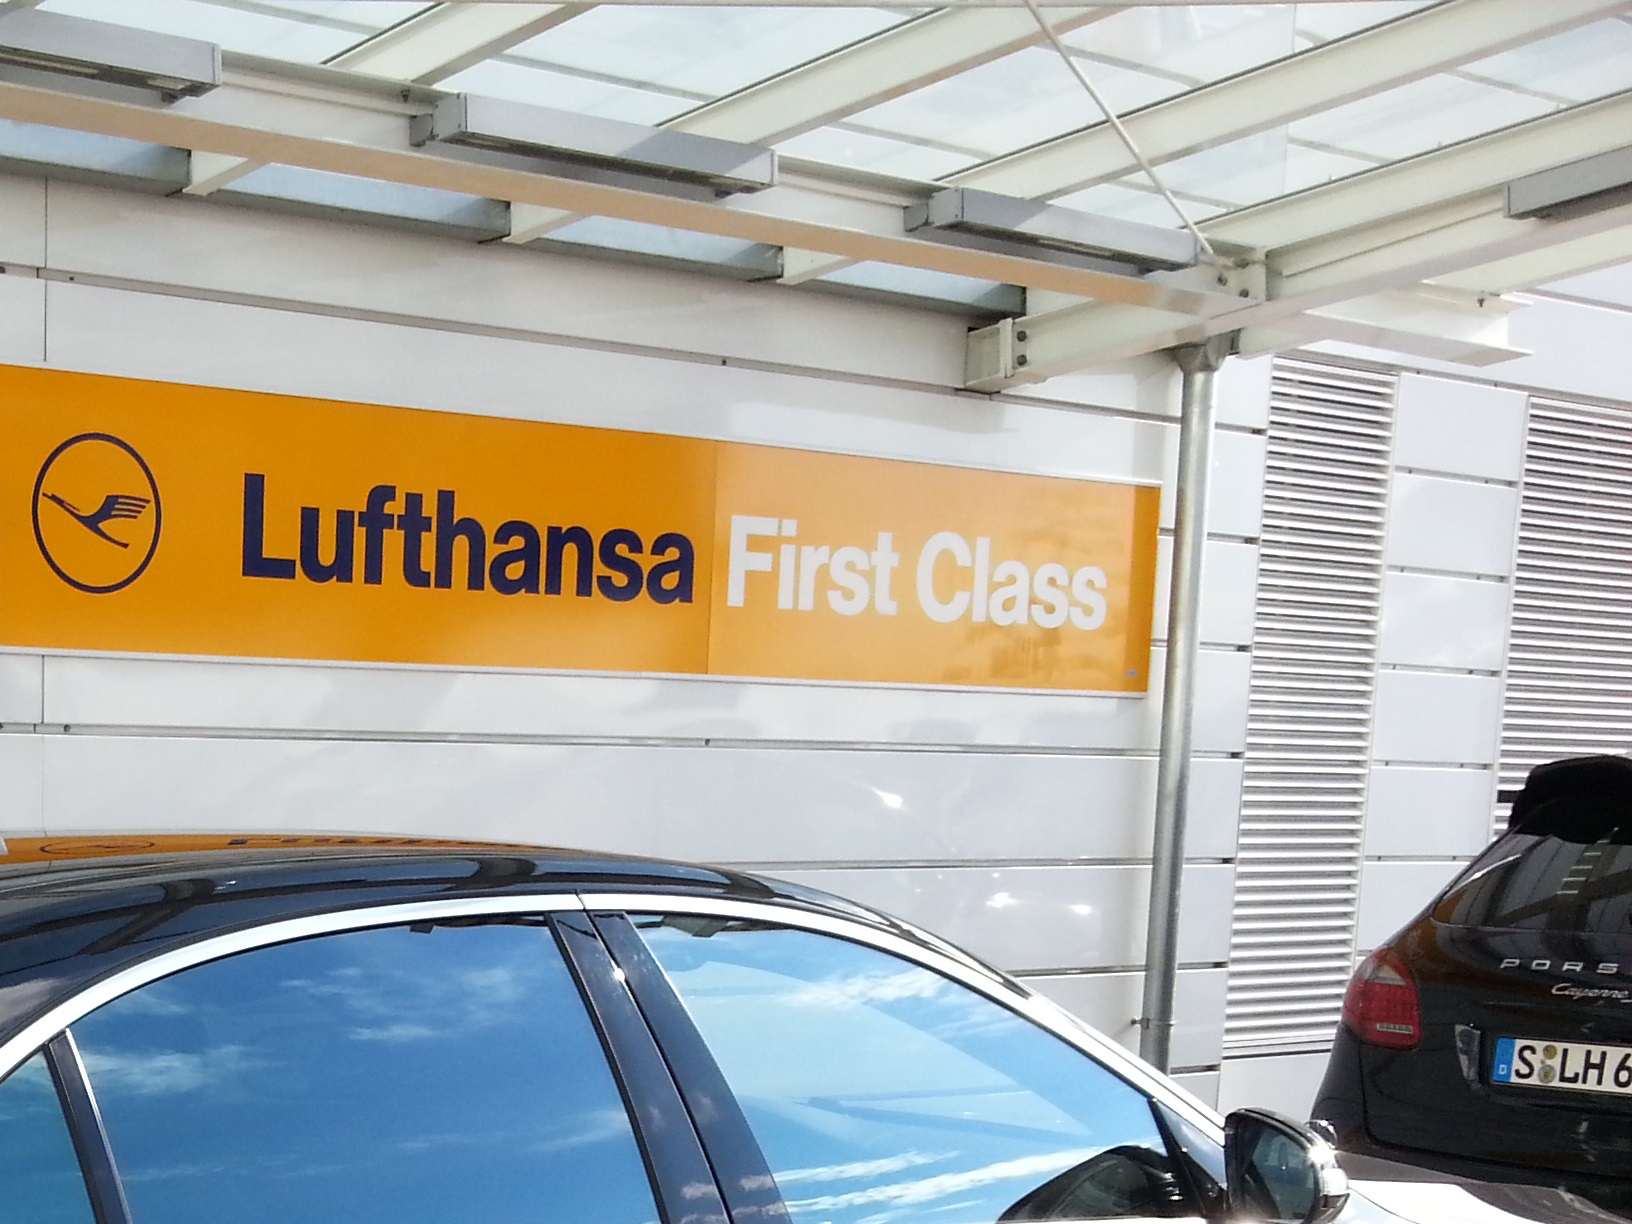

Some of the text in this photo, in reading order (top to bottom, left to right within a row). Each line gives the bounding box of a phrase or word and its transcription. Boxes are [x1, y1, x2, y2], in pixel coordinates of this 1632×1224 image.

[241, 472, 1109, 631] Lufthansa First Class
[1551, 983, 1630, 1000] Cayenne
[1498, 1064, 1507, 1075] D
[1514, 1044, 1537, 1079] S
[1558, 1047, 1607, 1086] LH
